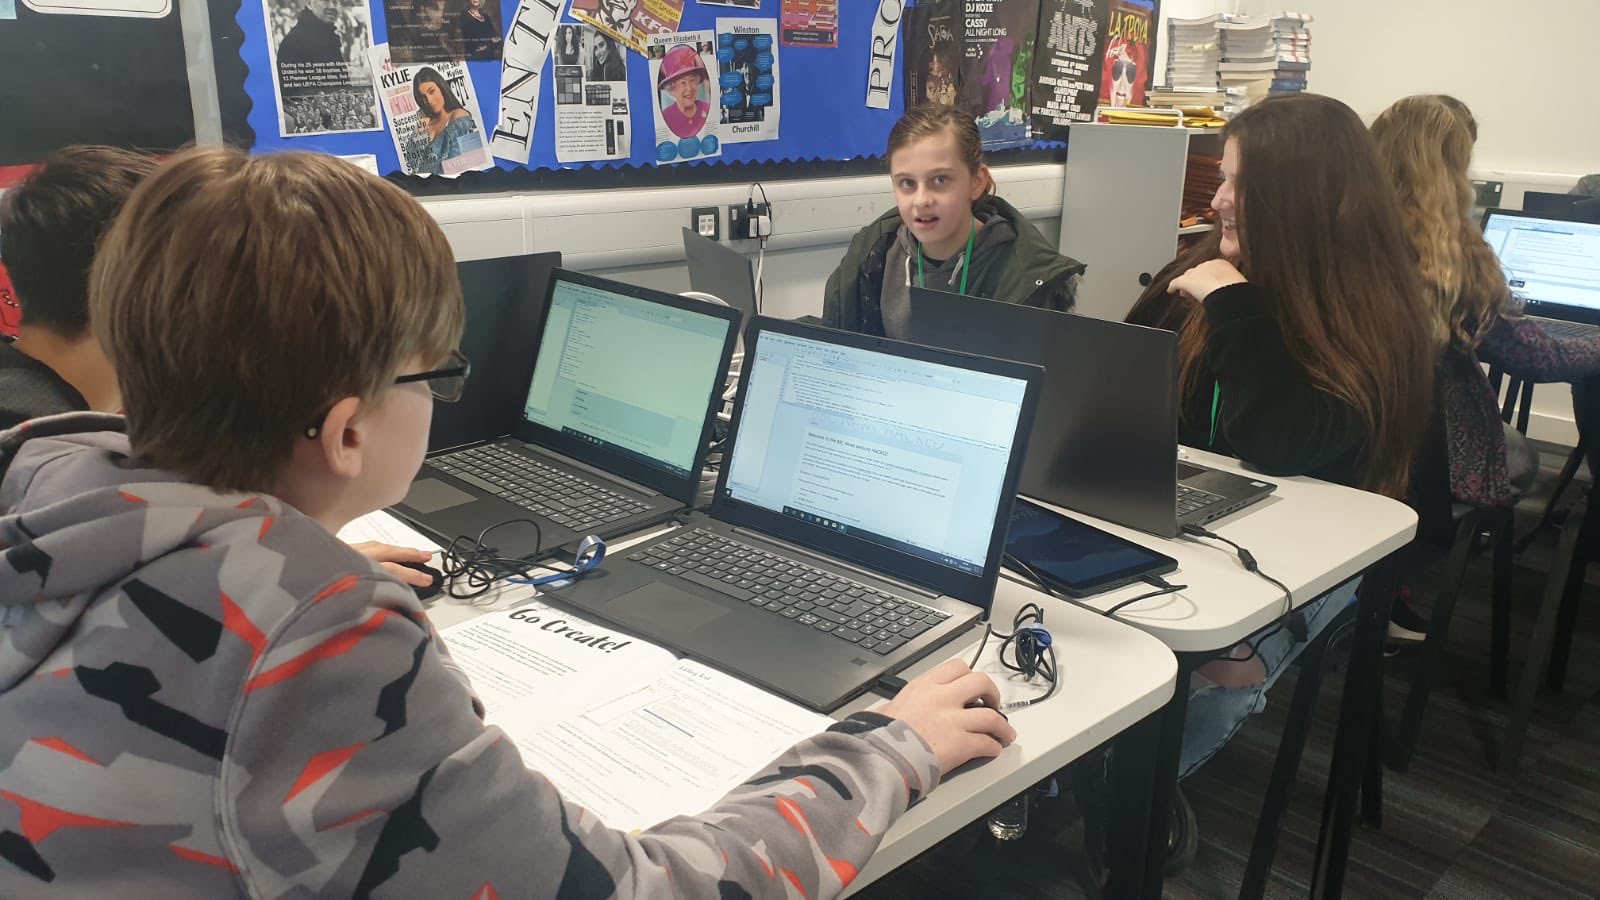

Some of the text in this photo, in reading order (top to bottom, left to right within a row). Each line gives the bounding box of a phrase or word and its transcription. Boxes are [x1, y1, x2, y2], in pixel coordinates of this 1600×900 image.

[965, 3, 993, 13] DJ KOZE
[965, 18, 988, 28] CASSY
[733, 25, 760, 34] Winston
[965, 27, 1007, 37] ALL NIGHT LONG
[673, 34, 697, 43] Elizabeth
[381, 68, 412, 88] KYLIE
[447, 68, 463, 79] Kylie
[396, 123, 416, 136] Make
[416, 120, 427, 132] Up
[732, 124, 760, 134] Churchill
[508, 608, 541, 624] Go
[540, 619, 633, 654] Create!
